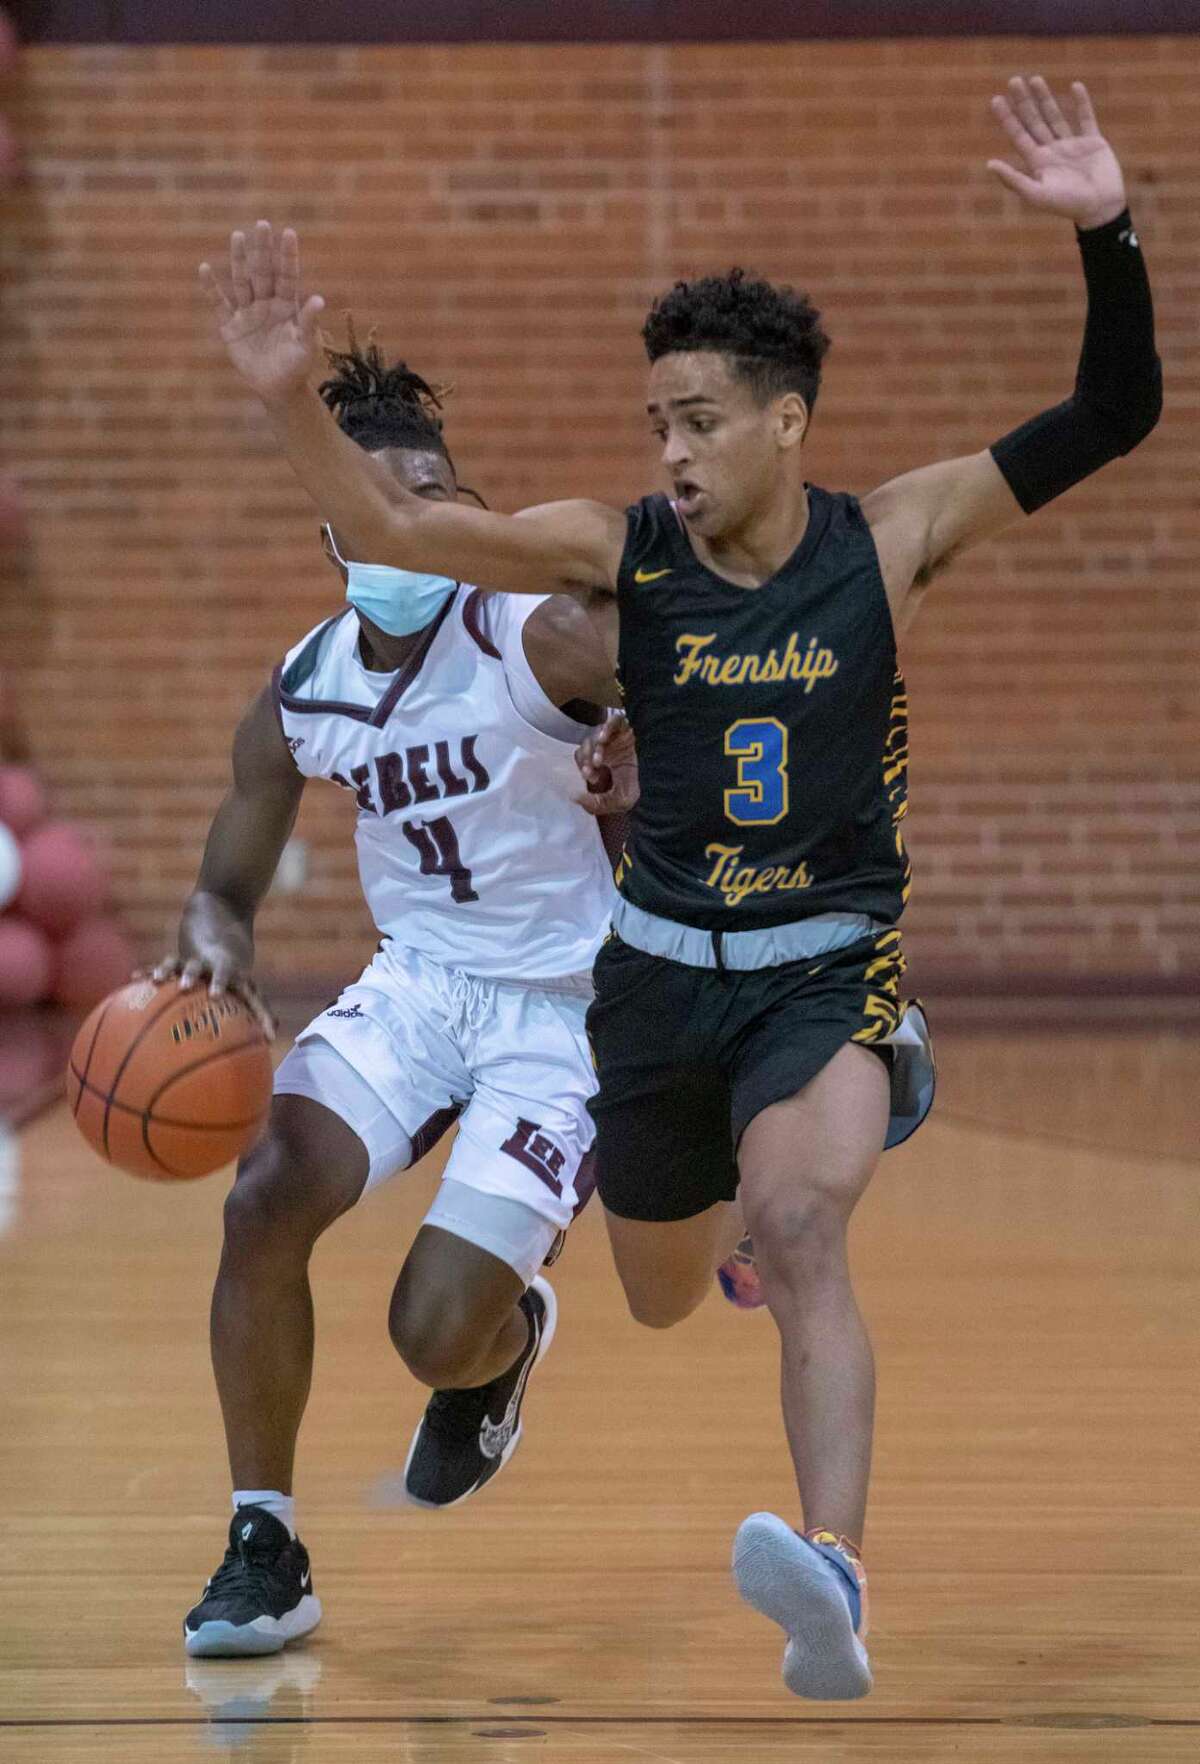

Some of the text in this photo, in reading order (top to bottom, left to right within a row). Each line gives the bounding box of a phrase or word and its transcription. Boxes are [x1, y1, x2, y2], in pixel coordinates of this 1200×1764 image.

[673, 632, 839, 694] Frenship
[723, 716, 789, 826] 3
[402, 815, 479, 903] 4
[704, 843, 814, 907] Tigers
